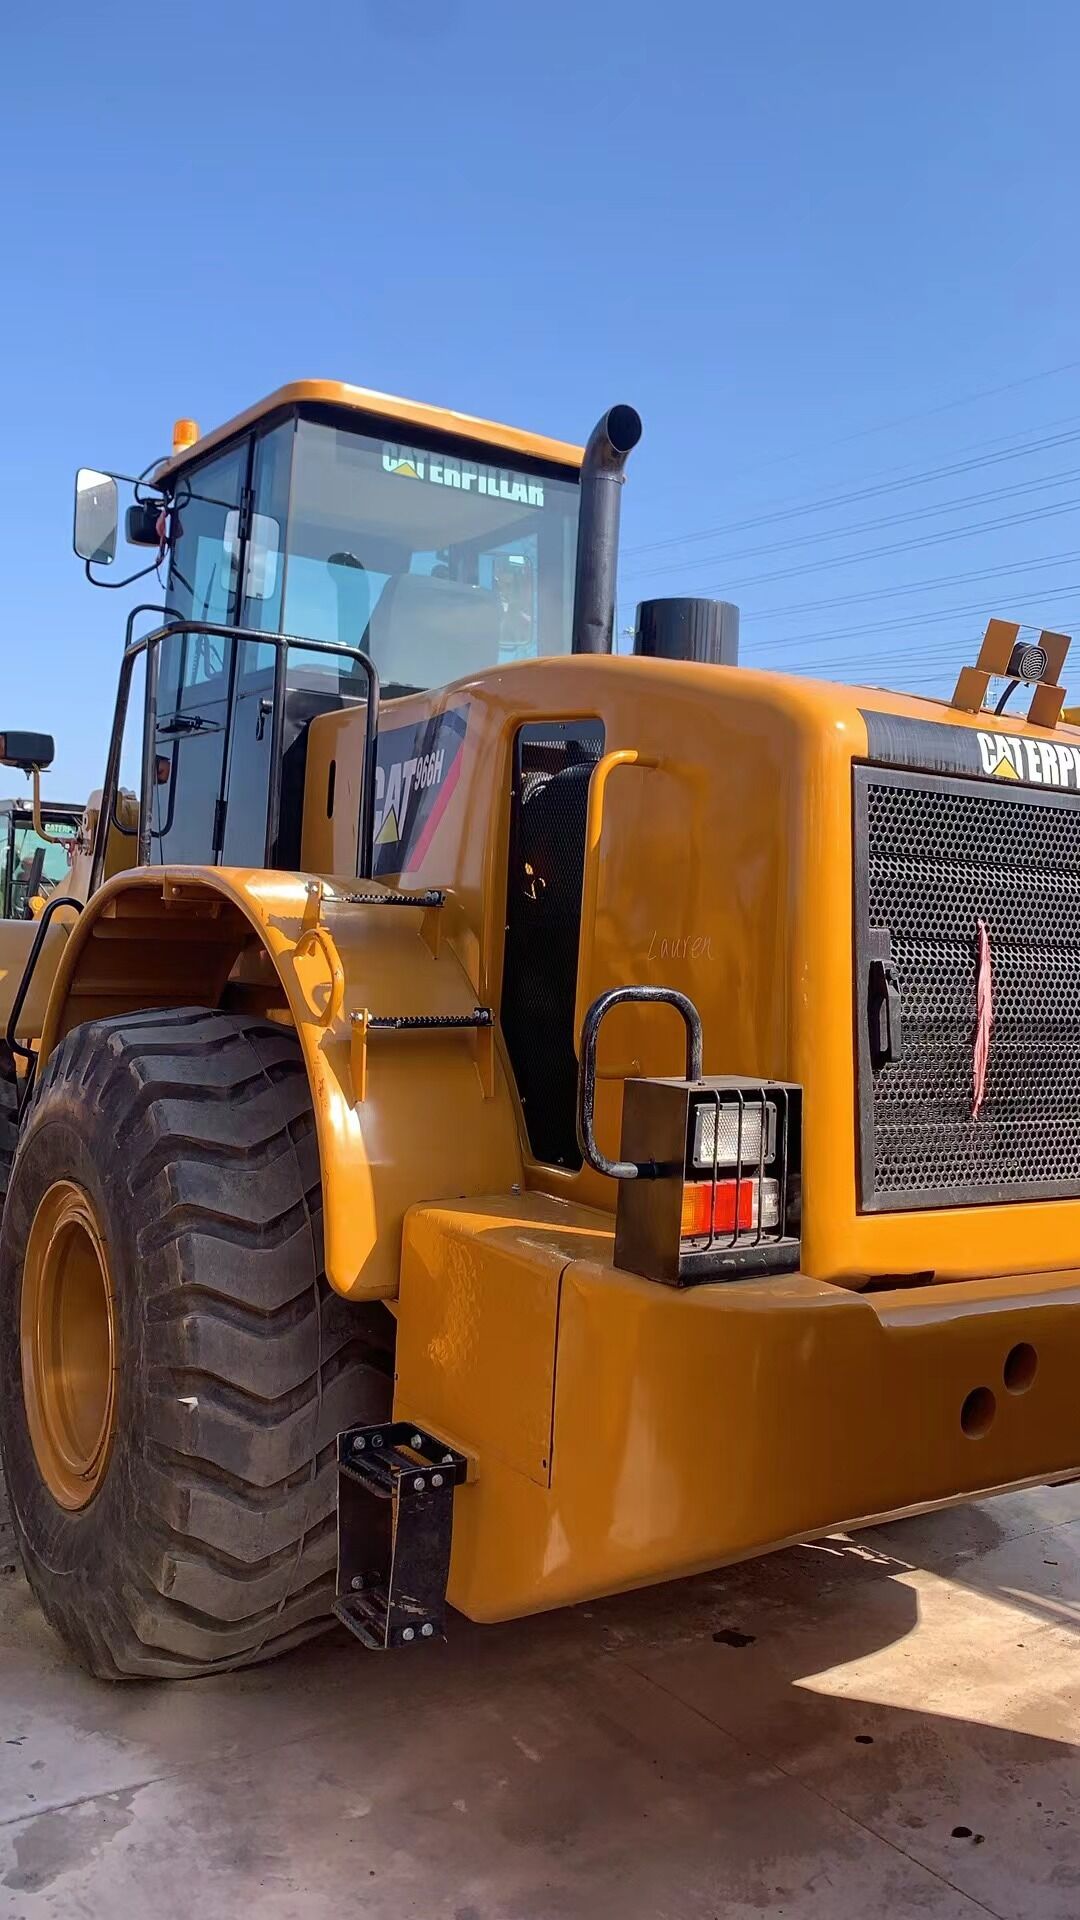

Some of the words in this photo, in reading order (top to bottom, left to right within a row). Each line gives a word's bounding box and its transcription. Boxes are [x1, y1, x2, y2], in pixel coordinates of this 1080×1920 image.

[382, 443, 544, 506] CATERPILLAR
[414, 749, 445, 791] 966H
[648, 930, 714, 960] Lauren
